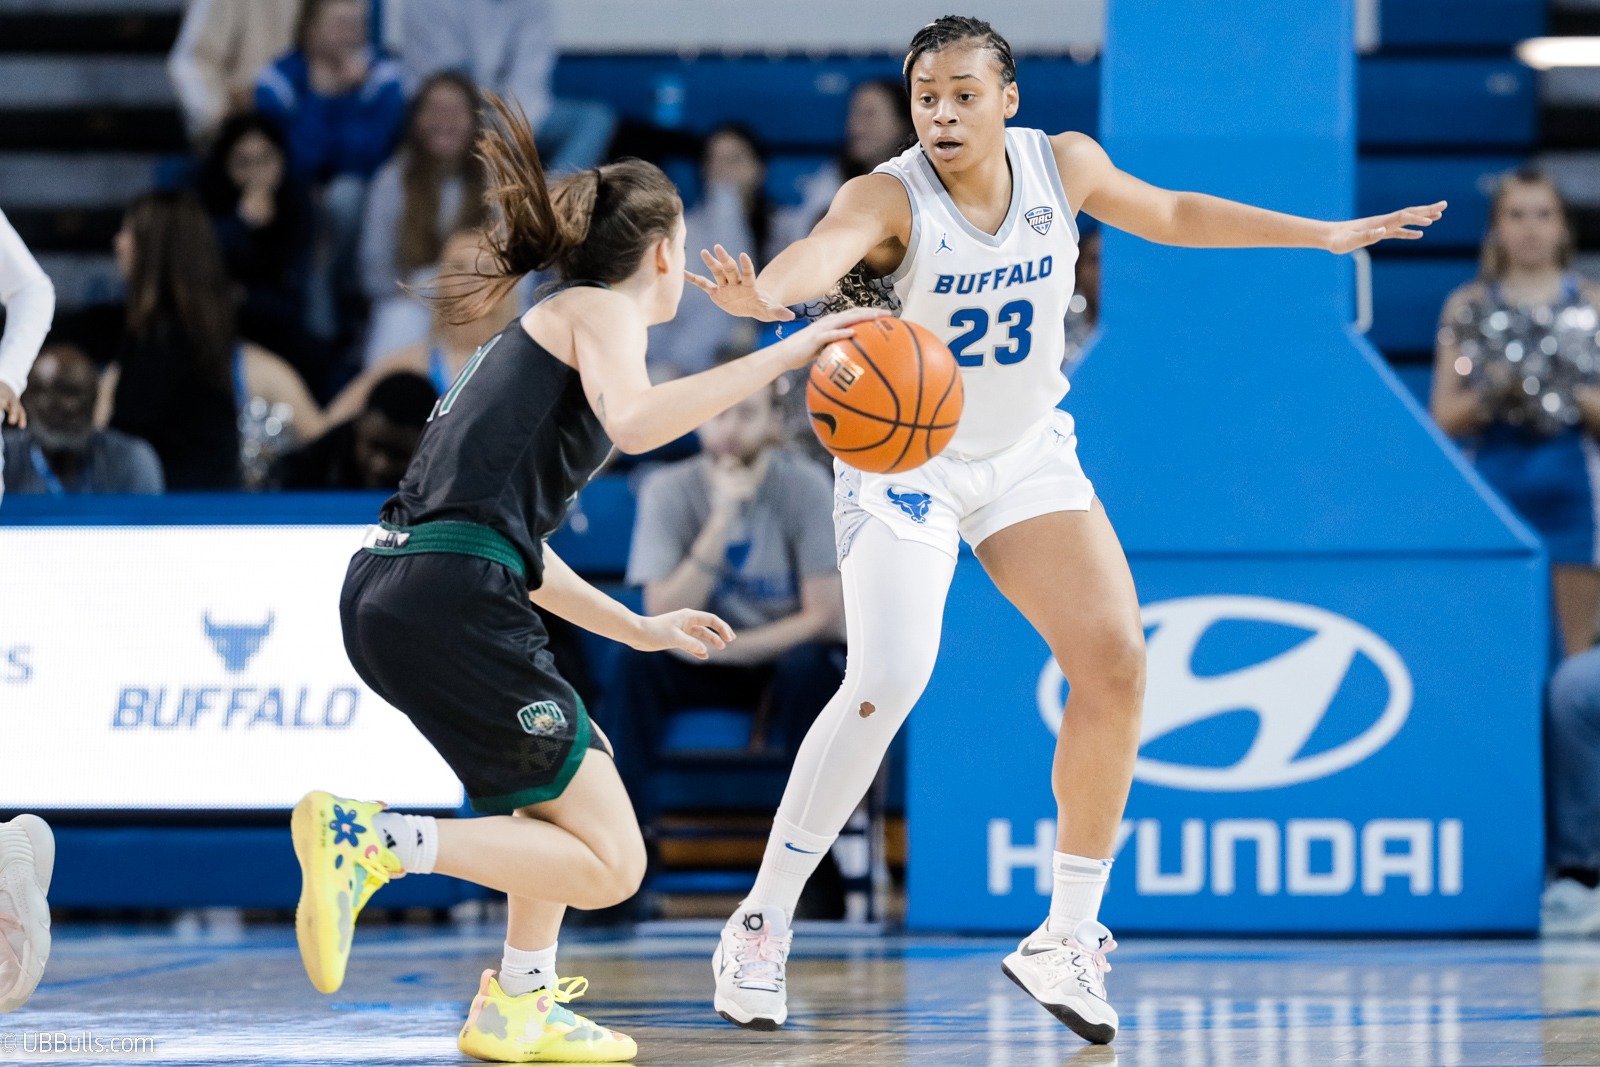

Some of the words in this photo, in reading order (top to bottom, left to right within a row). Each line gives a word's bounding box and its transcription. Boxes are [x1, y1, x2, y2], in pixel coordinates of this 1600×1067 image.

[1028, 212, 1053, 227] MAC
[929, 254, 1053, 295] BUFFALO
[946, 297, 1035, 368] 23
[111, 685, 362, 729] BUFFALO
